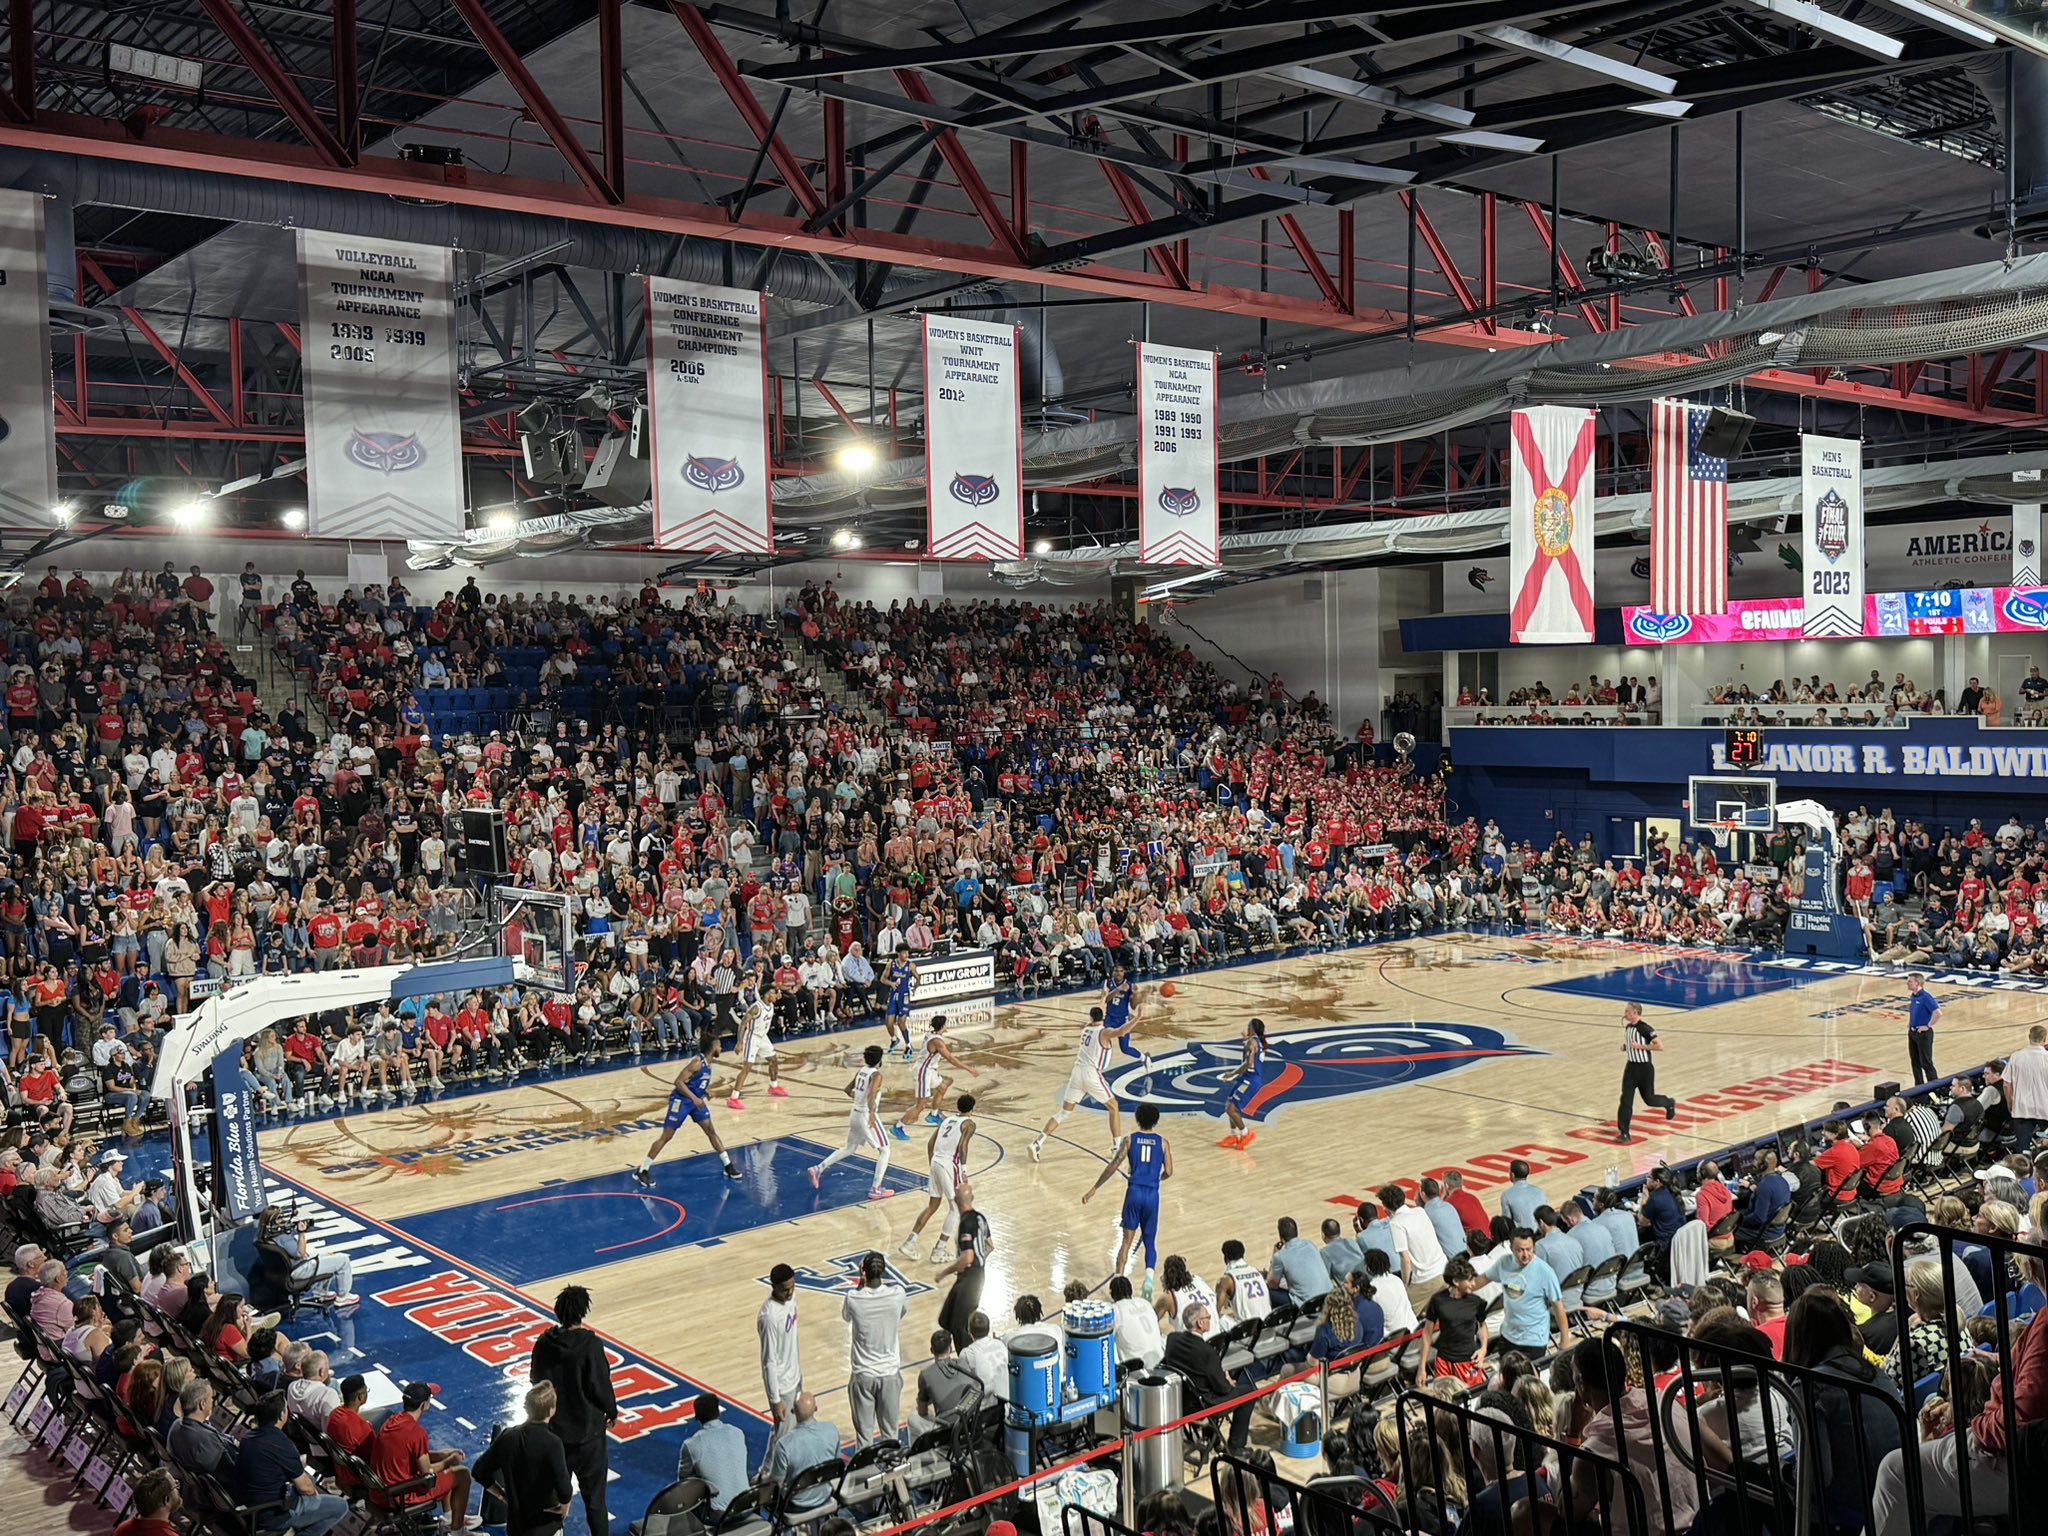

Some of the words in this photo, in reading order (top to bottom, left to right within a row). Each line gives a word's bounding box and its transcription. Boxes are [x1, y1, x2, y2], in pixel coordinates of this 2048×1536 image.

[336, 249, 417, 270] VOLLEYBALL
[360, 269, 396, 283] NCAA
[331, 282, 424, 303] TOURNAMENT
[336, 300, 421, 320] APPEARANCE
[653, 291, 697, 307] WOMEN'S
[700, 298, 758, 315] BASKETBALL
[673, 309, 740, 327] CONFERENCE
[385, 328, 426, 346] 1999
[670, 324, 743, 342] TOURNAMENT
[929, 328, 965, 341] WOMEN'S
[966, 333, 1012, 347] BASKETBALL
[331, 345, 375, 363] 2005
[677, 340, 738, 356] CHAMPIONS
[960, 345, 983, 356] WNIT
[671, 360, 705, 376] 2006
[942, 357, 1000, 371] TOURNAMENT
[1143, 355, 1173, 366] WOMEN'S
[1173, 359, 1211, 371] BASKETBALL
[945, 370, 999, 384] APPEARANCE
[1169, 370, 1187, 380] NCAA
[939, 388, 965, 402] 2012
[1154, 381, 1202, 394] TOURNAMENT
[1156, 393, 1200, 405] APPEARANCE
[1155, 409, 1176, 421] 1989
[1181, 412, 1202, 424] 1990
[1155, 425, 1176, 437] 1991
[1181, 428, 1202, 439] 1993
[1154, 441, 1177, 453] 2006
[1822, 451, 1842, 463] MEN'S
[1812, 465, 1857, 479] BASKETBALL
[1821, 507, 1845, 525] FINAL
[1823, 524, 1846, 542] FOUR
[1912, 557, 1961, 567] ATHLETIC
[1813, 571, 1850, 595] 2023
[1914, 591, 1951, 608] 7:10
[1883, 613, 1902, 628] 21
[1968, 610, 1989, 625] 14
[1735, 731, 1757, 742] 7:10
[1731, 743, 1753, 761] 27
[1862, 745, 1896, 774] R.
[1902, 746, 2048, 777] BALDWI
[1807, 914, 1831, 924] Baptist
[1807, 923, 1830, 932] Health
[936, 971, 957, 983] LAW
[957, 965, 988, 979] GROUP
[1112, 997, 1120, 1005] 12
[192, 1022, 228, 1056] SPALDING
[1081, 1034, 1091, 1047] 50
[856, 1078, 865, 1091] 12
[241, 1089, 251, 1121] Partner
[225, 1122, 241, 1153] Blue
[942, 1125, 952, 1138] 2
[244, 1122, 255, 1159] Solutions
[1141, 1145, 1151, 1162] 11
[248, 1160, 260, 1188] Health
[231, 1155, 250, 1210] Florida
[253, 1188, 263, 1207] Your
[1244, 1280, 1264, 1299] 23
[1102, 1339, 1110, 1387] POWERADE
